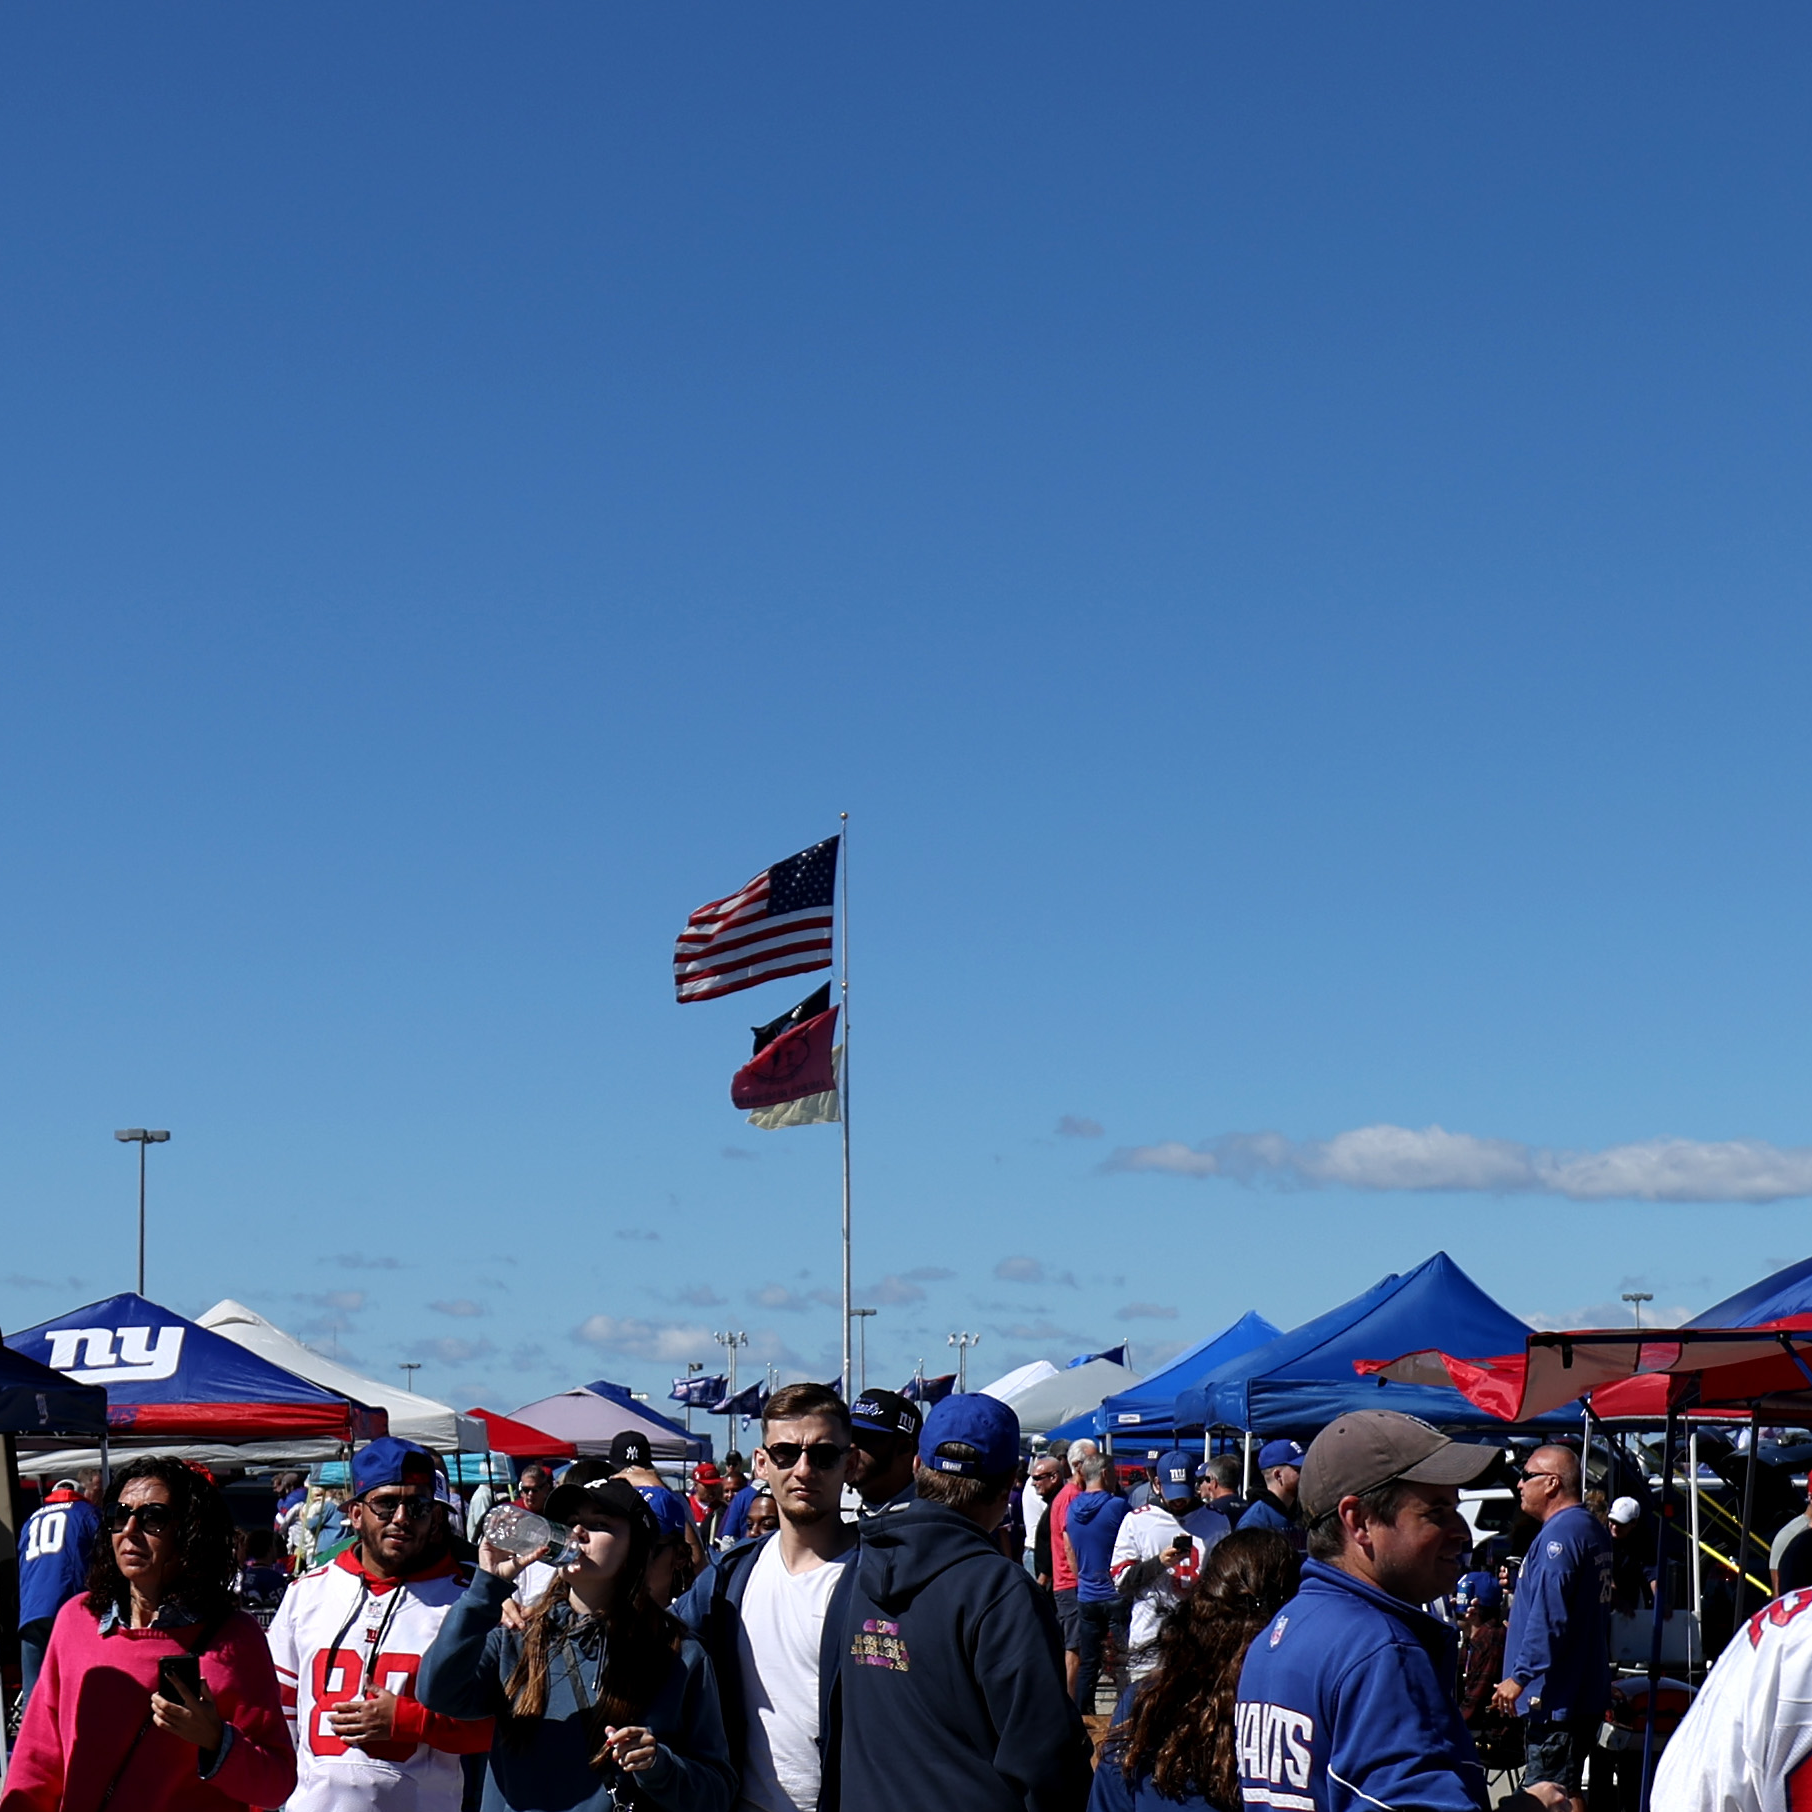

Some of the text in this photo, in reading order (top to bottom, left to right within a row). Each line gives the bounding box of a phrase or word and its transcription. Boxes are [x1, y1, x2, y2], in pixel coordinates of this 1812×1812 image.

[44, 1326, 185, 1384] ny
[896, 1411, 917, 1434] ny
[25, 1511, 67, 1561] 10
